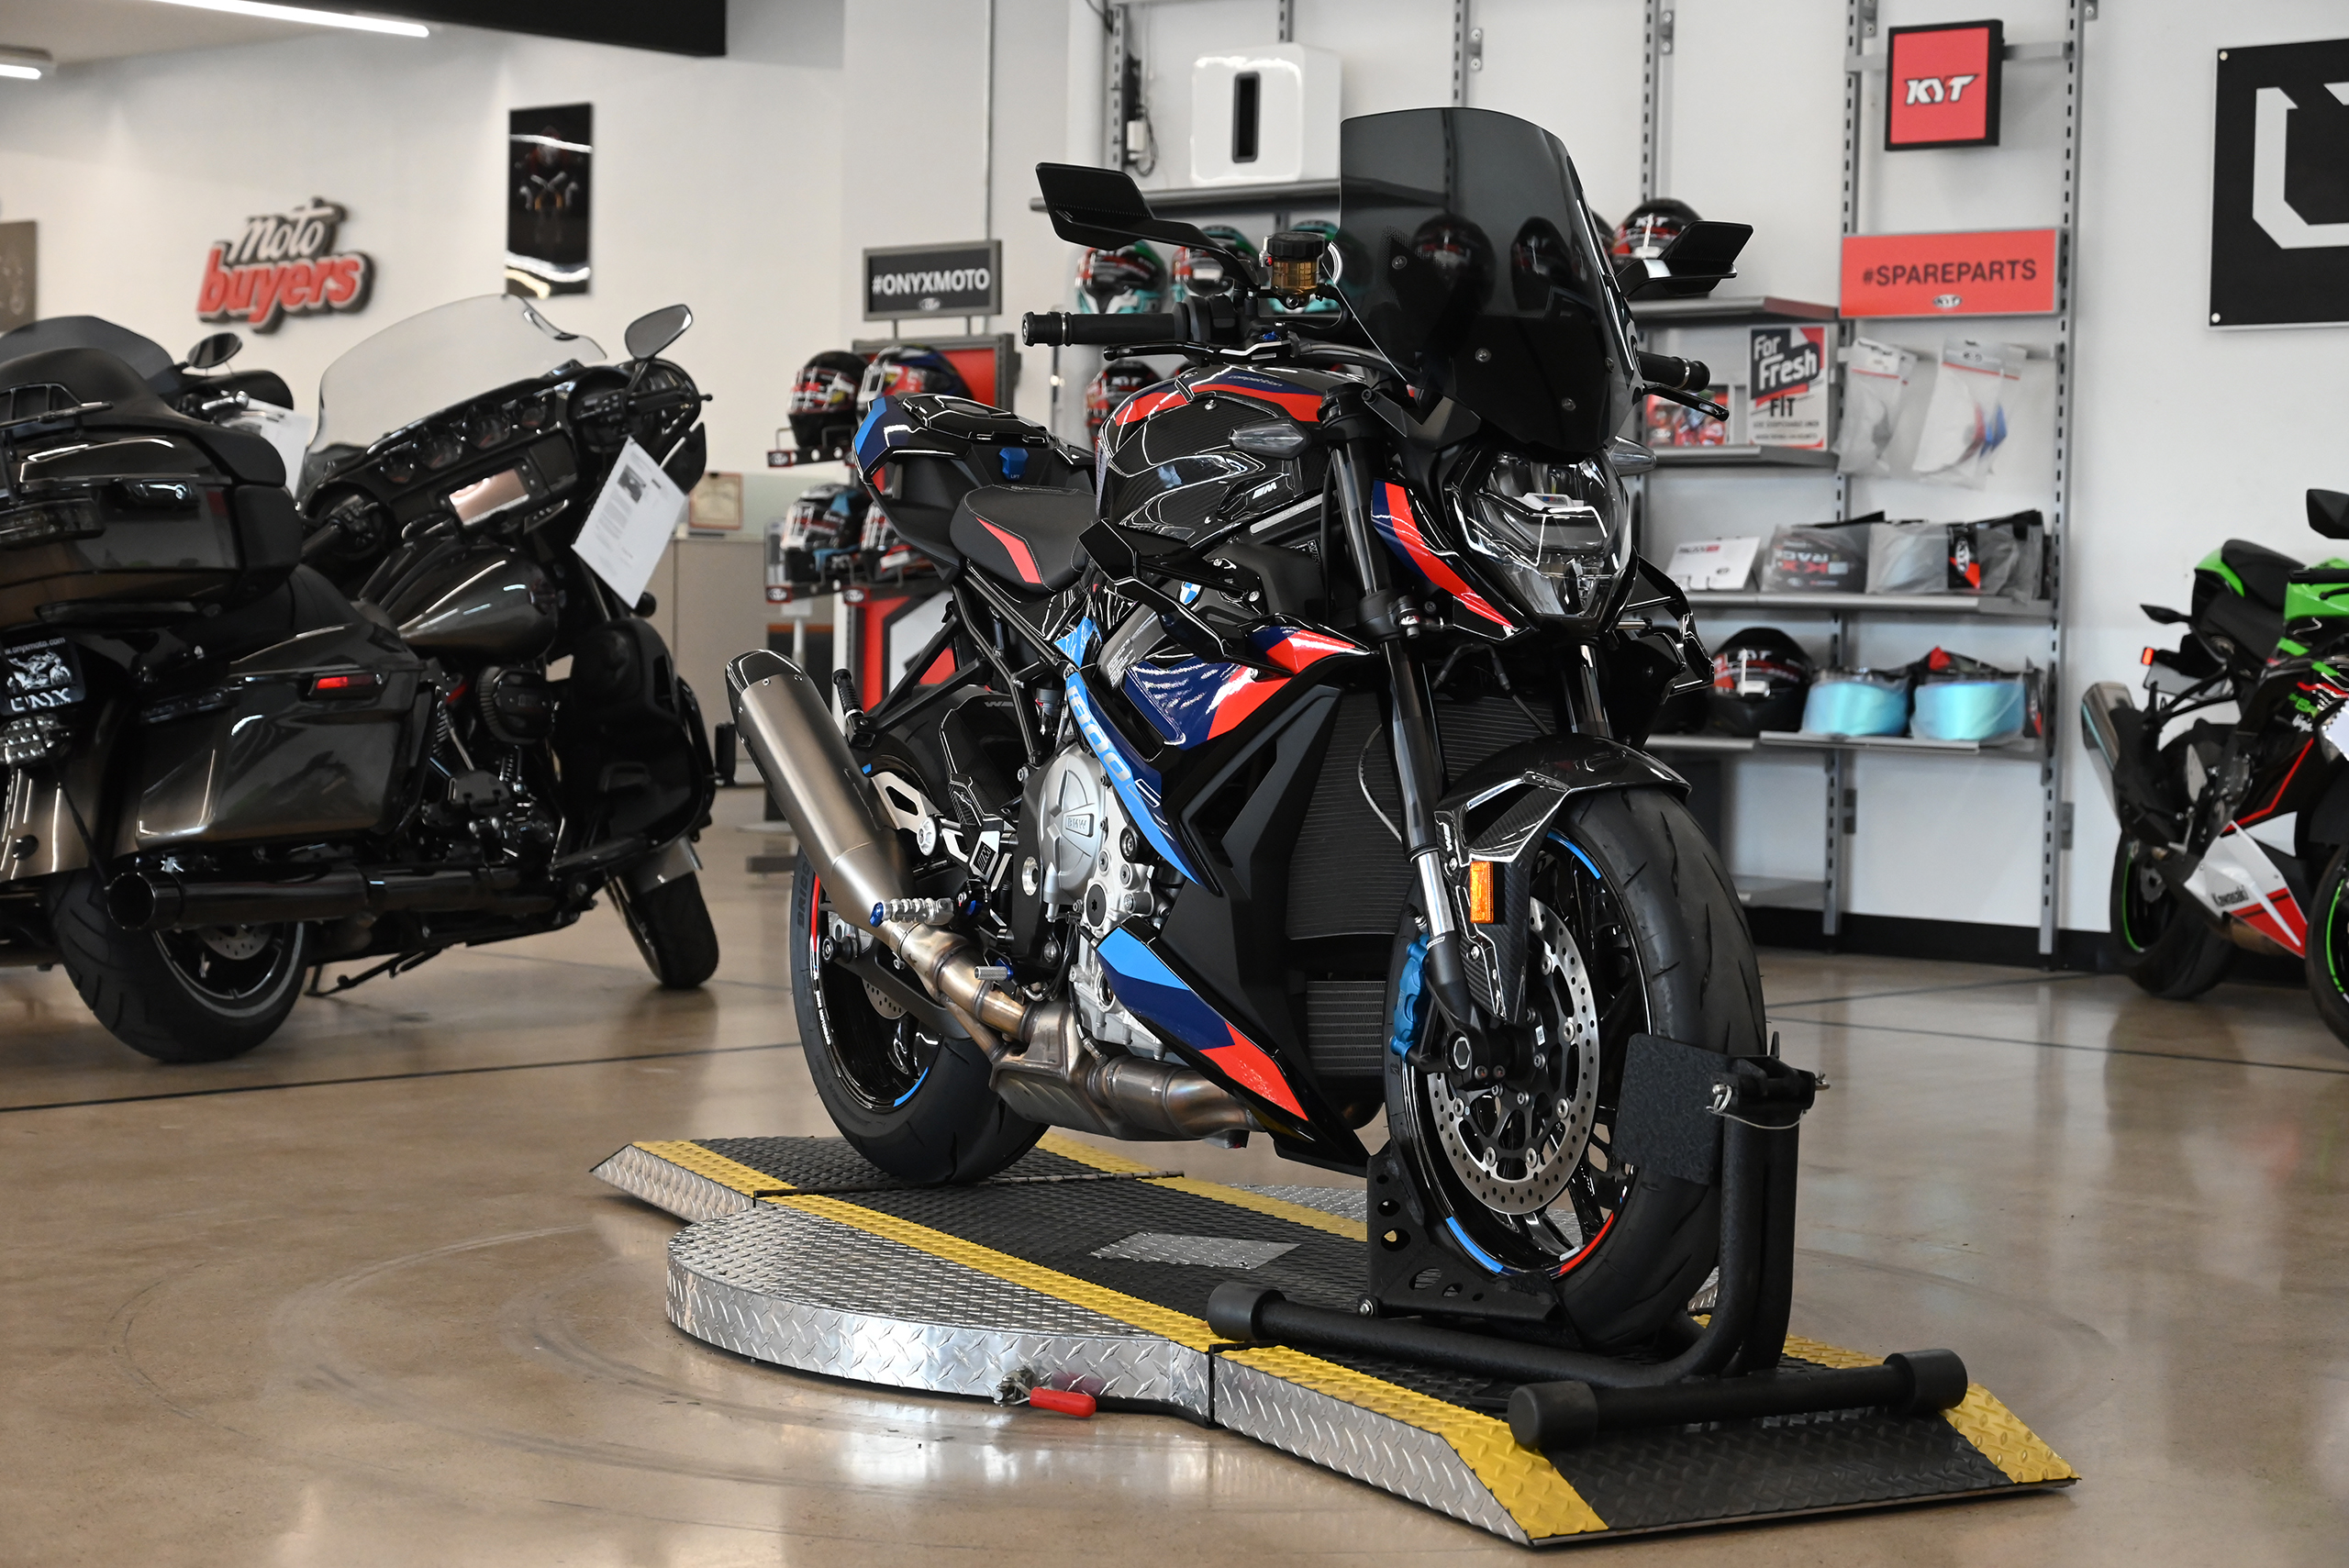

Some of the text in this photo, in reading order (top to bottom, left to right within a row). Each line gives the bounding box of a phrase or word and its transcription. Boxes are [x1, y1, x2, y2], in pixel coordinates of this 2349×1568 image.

[1906, 74, 1978, 106] KYT
[196, 246, 361, 324] buyers
[872, 268, 991, 295] #ONYXMOTO
[1862, 259, 2037, 287] #SPAREPARTS
[1753, 334, 1782, 361] For
[1227, 375, 1284, 387] competition
[1759, 349, 1817, 391] Fresh
[4, 637, 66, 655] w.onyxmoto.com
[1066, 684, 1132, 782] 1000
[1067, 817, 1087, 831] BMW
[2211, 885, 2249, 906] Kawasaki
